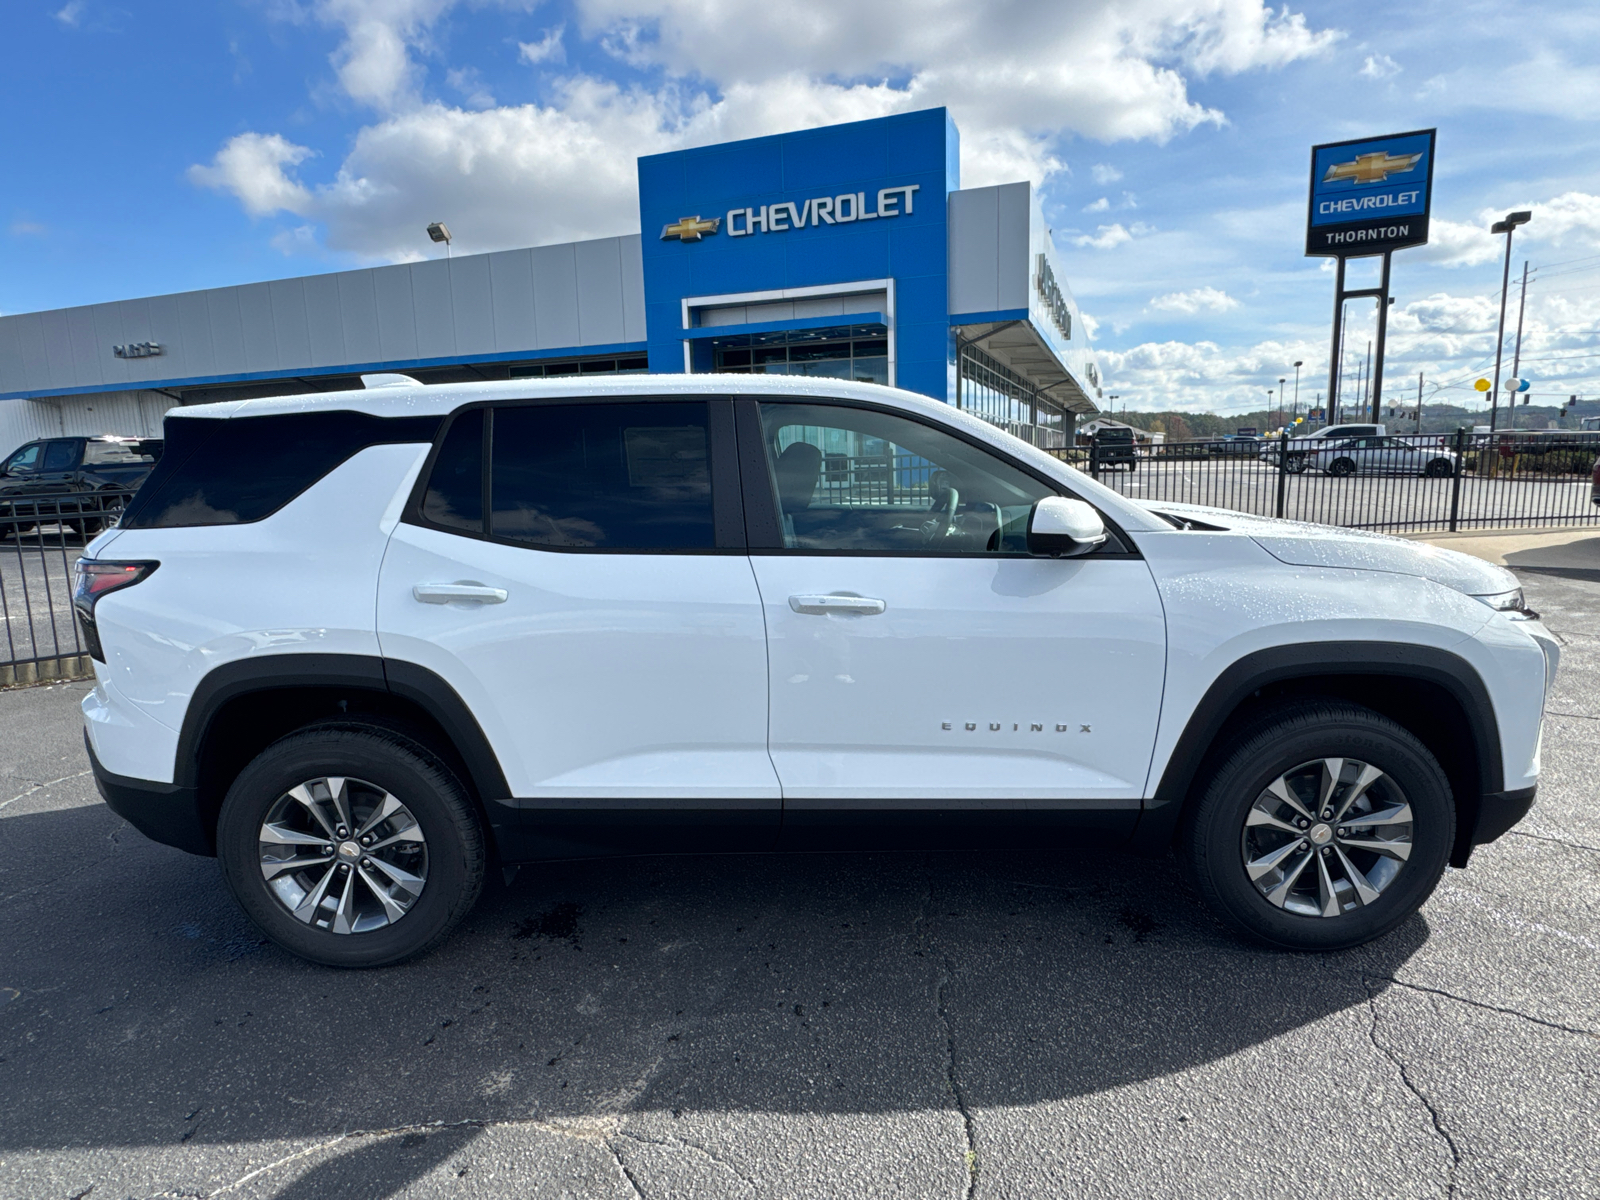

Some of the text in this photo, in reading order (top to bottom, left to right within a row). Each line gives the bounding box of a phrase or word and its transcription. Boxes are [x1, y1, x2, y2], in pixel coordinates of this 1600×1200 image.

[727, 184, 920, 237] CHEVROLET
[1320, 191, 1420, 214] CHEVROLET
[1326, 225, 1409, 244] THORNTON
[941, 720, 1092, 734] EQUINOX
